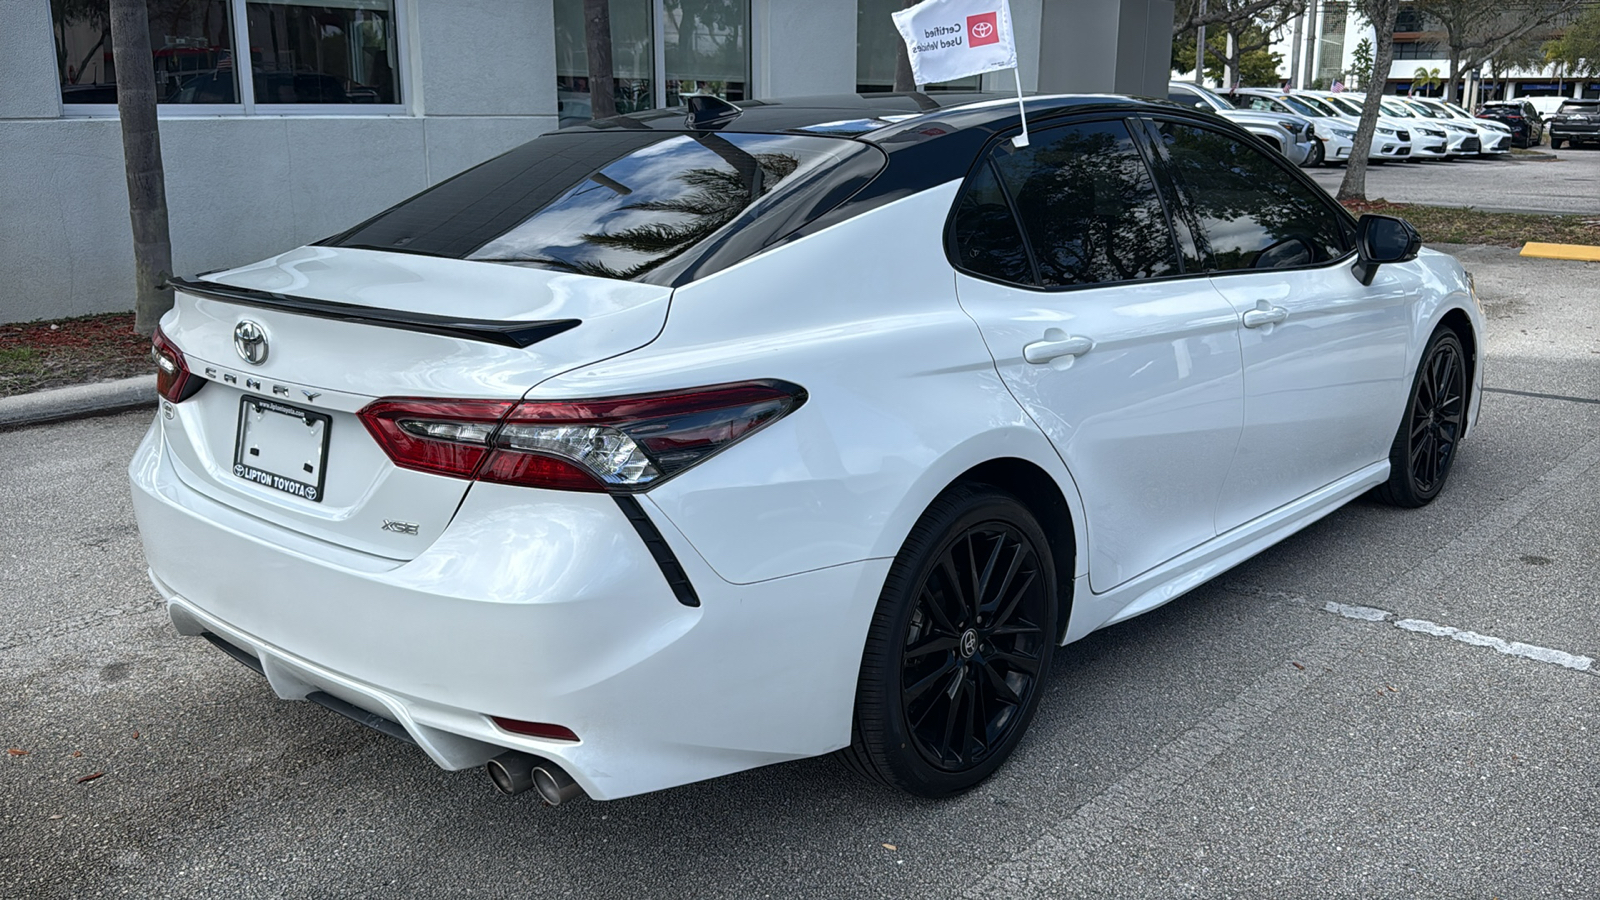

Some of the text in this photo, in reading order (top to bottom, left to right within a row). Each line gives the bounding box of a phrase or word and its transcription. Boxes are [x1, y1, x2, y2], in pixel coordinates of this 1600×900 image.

[205, 367, 321, 402] CAMRY
[245, 468, 305, 497] LIPTON TOYOTA
[381, 519, 419, 536] XSE
